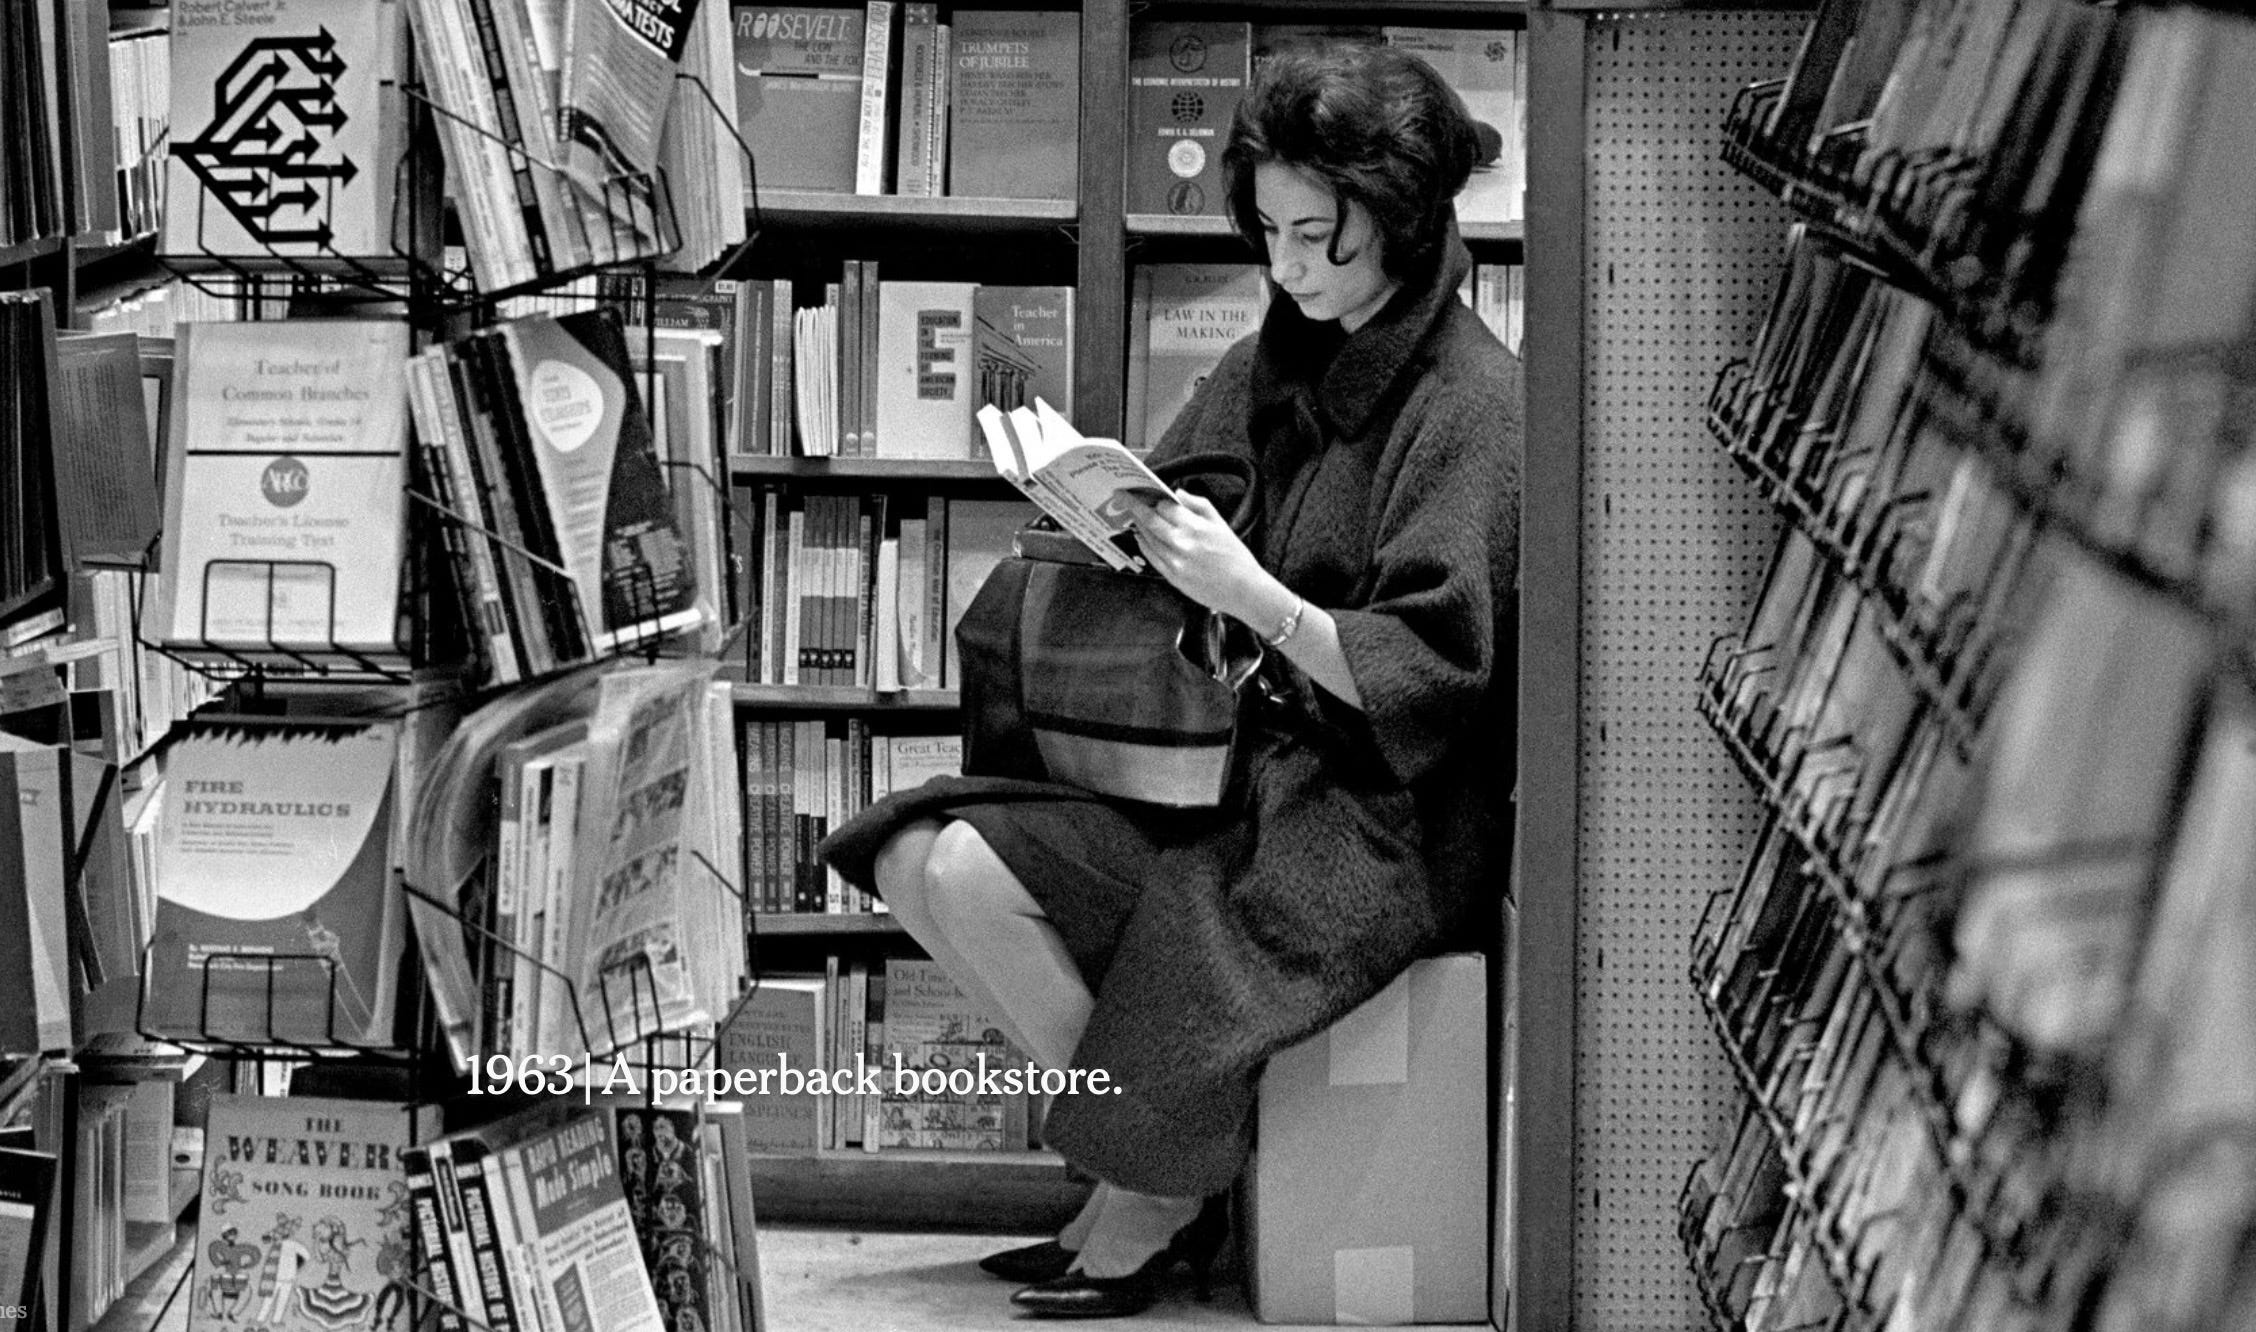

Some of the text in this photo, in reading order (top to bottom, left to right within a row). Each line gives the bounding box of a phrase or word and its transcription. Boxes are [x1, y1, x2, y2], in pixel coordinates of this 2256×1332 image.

[1012, 304, 1059, 318] Teacher
[1164, 310, 1246, 322] LAW IN THE
[1014, 322, 1025, 331] in
[1178, 327, 1236, 339] MAKING
[1015, 334, 1064, 347] America
[221, 384, 370, 401] Common Branches
[184, 780, 244, 794] FIRE
[183, 800, 351, 817] HYDRAULICS
[305, 1117, 345, 1133] THE
[535, 1145, 613, 1211] Made Simple
[252, 1181, 380, 1201] SONG BOOK
